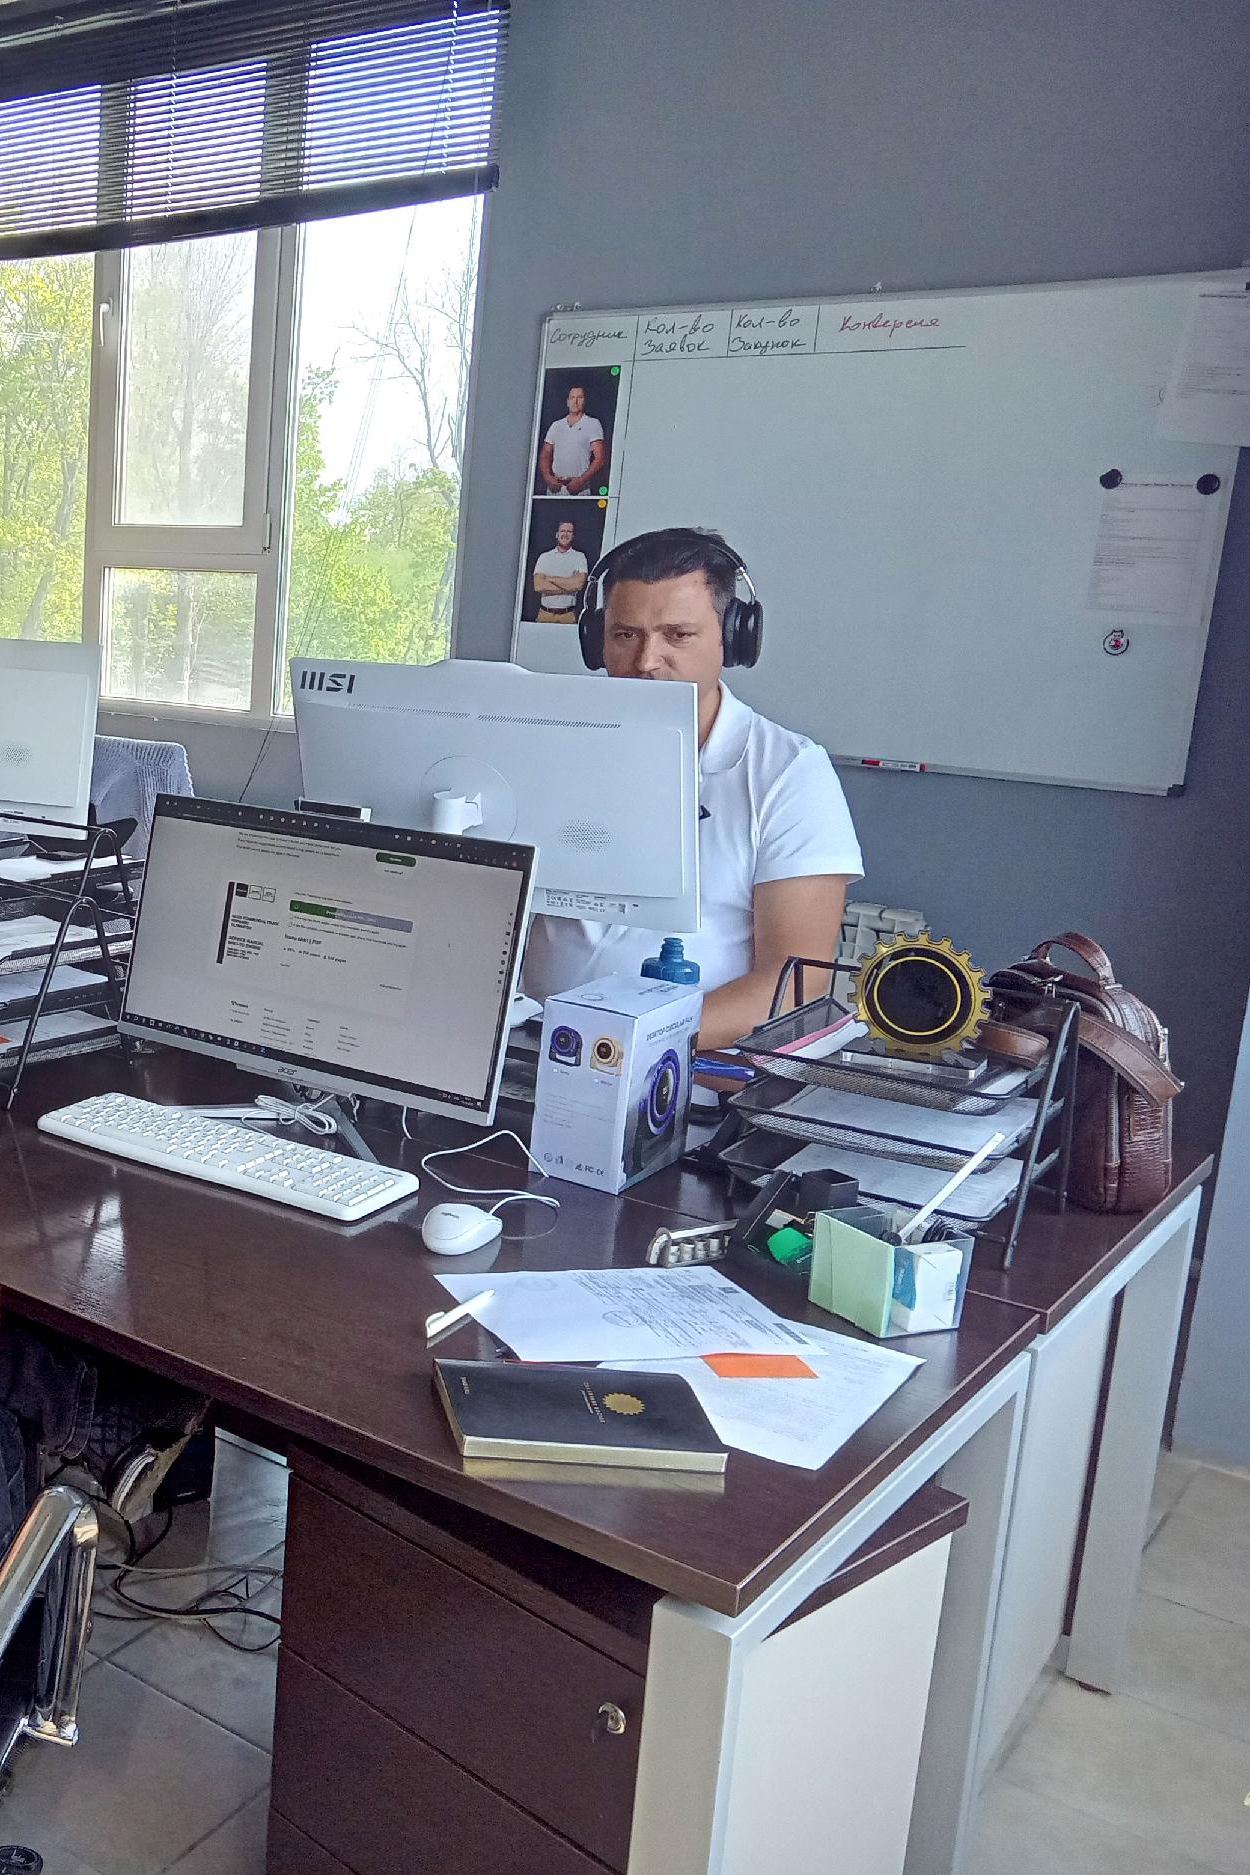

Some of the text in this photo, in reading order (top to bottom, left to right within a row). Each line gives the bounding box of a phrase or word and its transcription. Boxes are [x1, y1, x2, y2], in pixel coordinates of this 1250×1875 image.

[643, 314, 715, 335] Кол-во
[735, 308, 801, 330] Кол-во
[549, 327, 628, 348] Сотрудник
[640, 333, 711, 356] Заявок
[299, 670, 356, 694] MSI
[277, 1065, 298, 1076] acer
